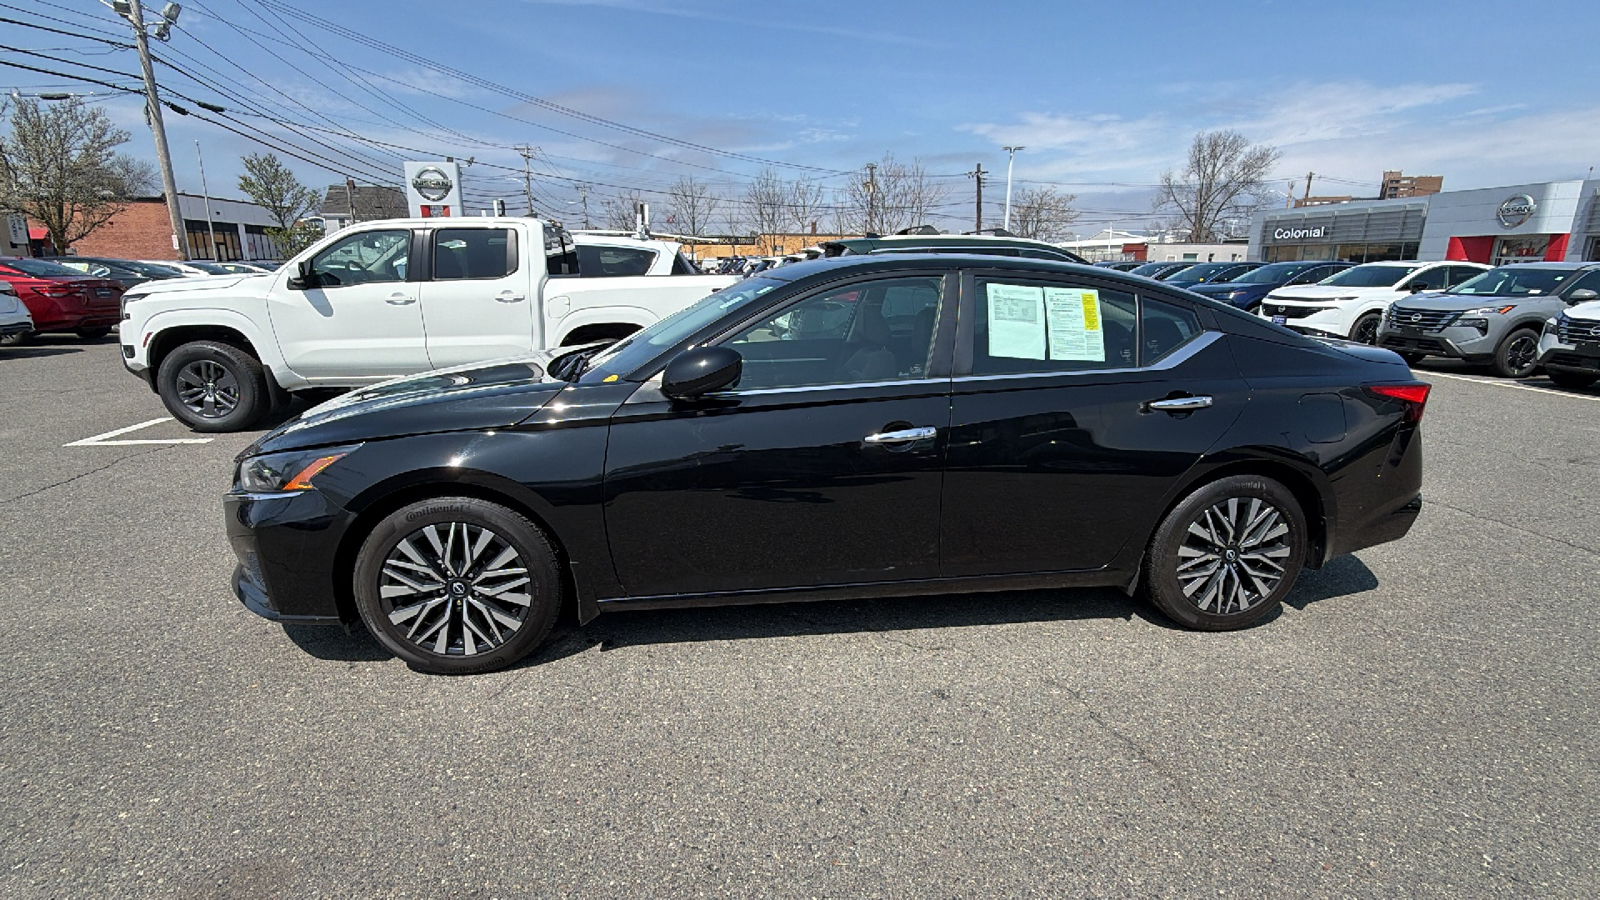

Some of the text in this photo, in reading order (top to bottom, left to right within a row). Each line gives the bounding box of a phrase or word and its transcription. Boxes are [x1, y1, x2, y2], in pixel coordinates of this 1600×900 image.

[414, 180, 449, 188] NISSAN
[1499, 206, 1532, 214] NISSAN
[1274, 226, 1325, 239] Colonial
[405, 504, 464, 522] Continental
